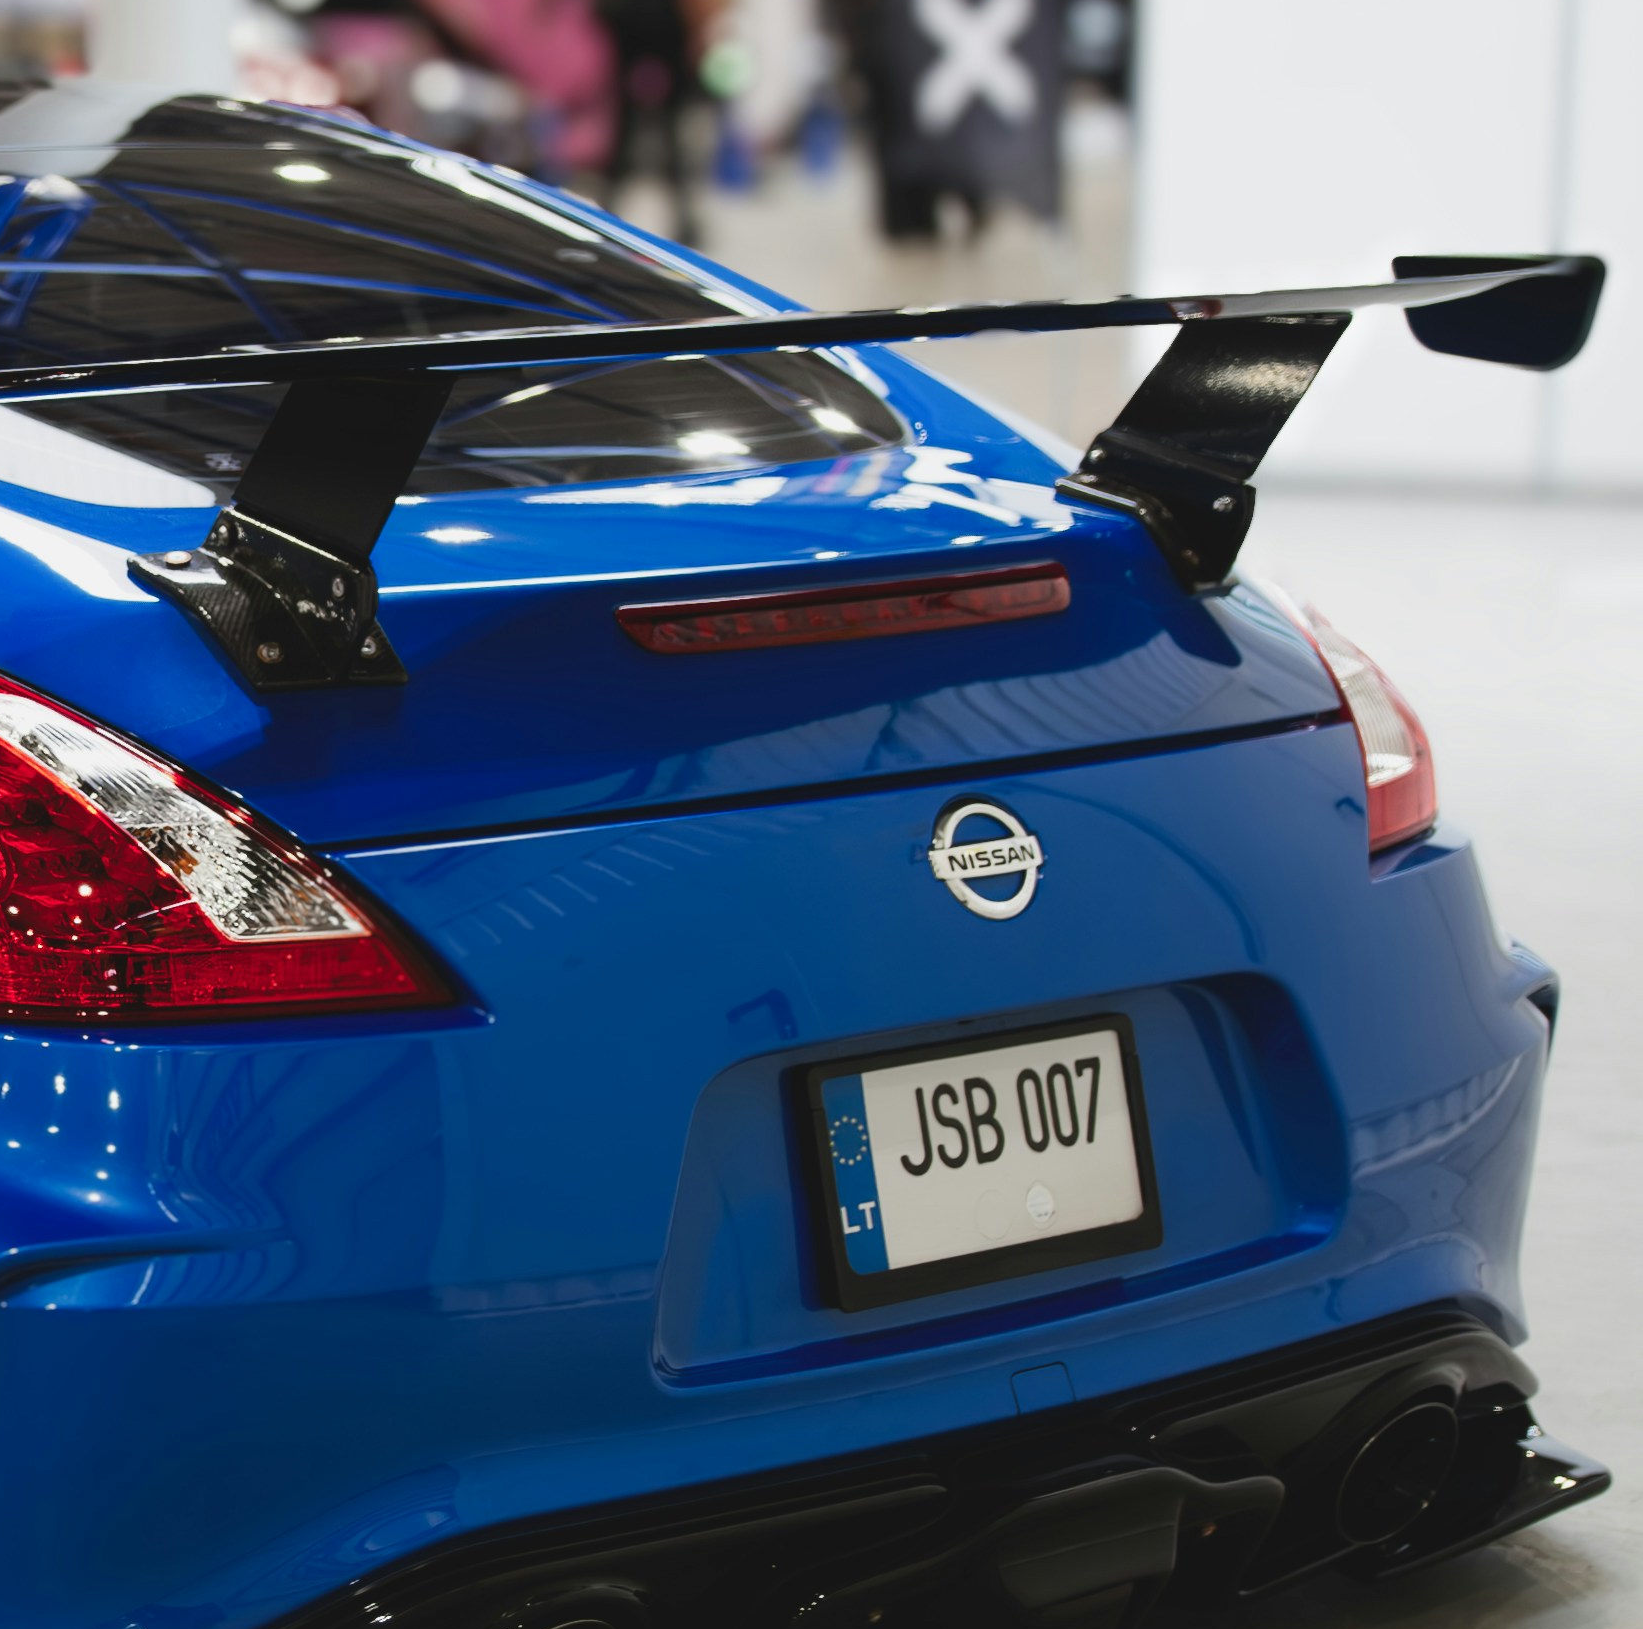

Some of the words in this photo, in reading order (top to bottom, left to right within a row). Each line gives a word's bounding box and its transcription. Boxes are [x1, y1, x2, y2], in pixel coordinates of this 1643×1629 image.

[947, 843, 1035, 872] NISSAN
[900, 1076, 1005, 1176] JSB
[1016, 1056, 1100, 1152] 007
[840, 1200, 876, 1235] LT
